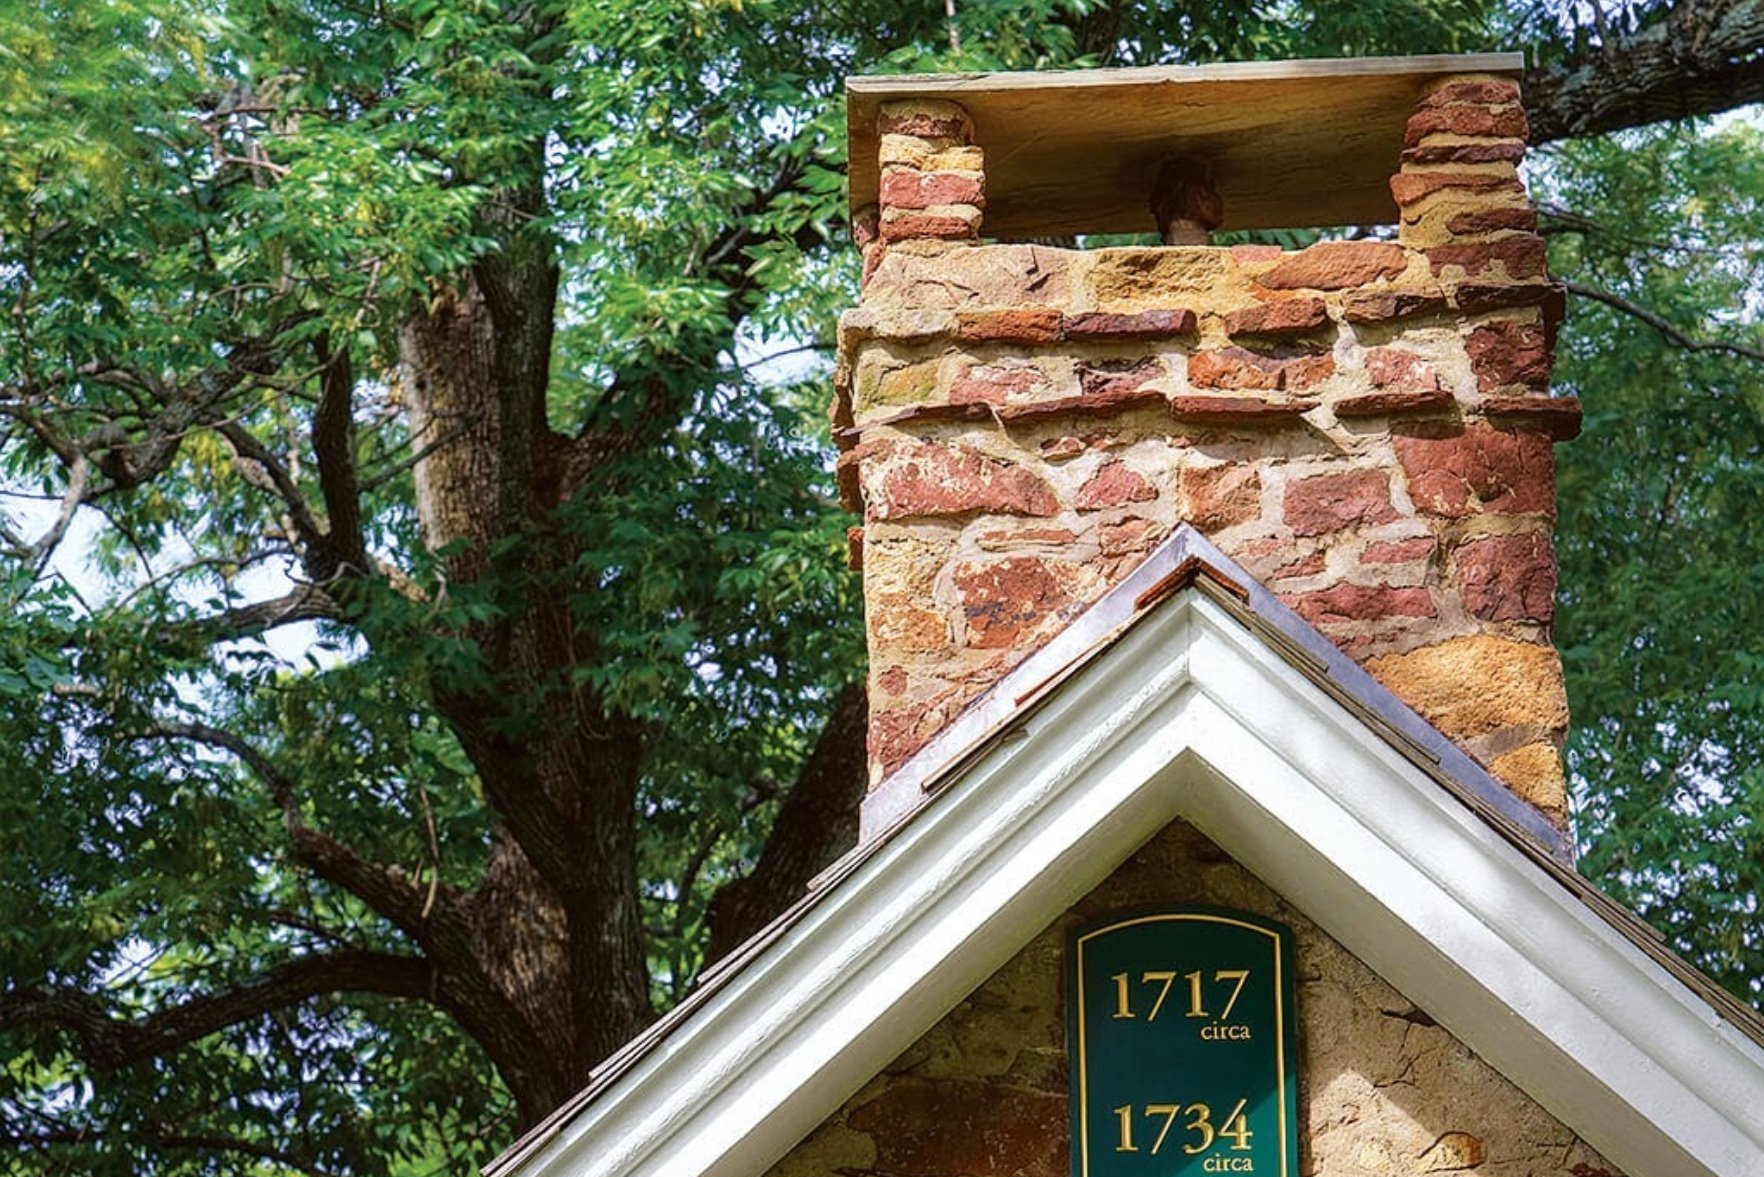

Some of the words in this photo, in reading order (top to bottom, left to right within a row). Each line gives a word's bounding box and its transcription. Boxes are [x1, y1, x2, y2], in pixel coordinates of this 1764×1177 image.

[1111, 970, 1249, 1021] 1717
[1200, 1021, 1251, 1040] circa
[1113, 1098, 1254, 1155] 1734
[1203, 1153, 1254, 1172] circa
